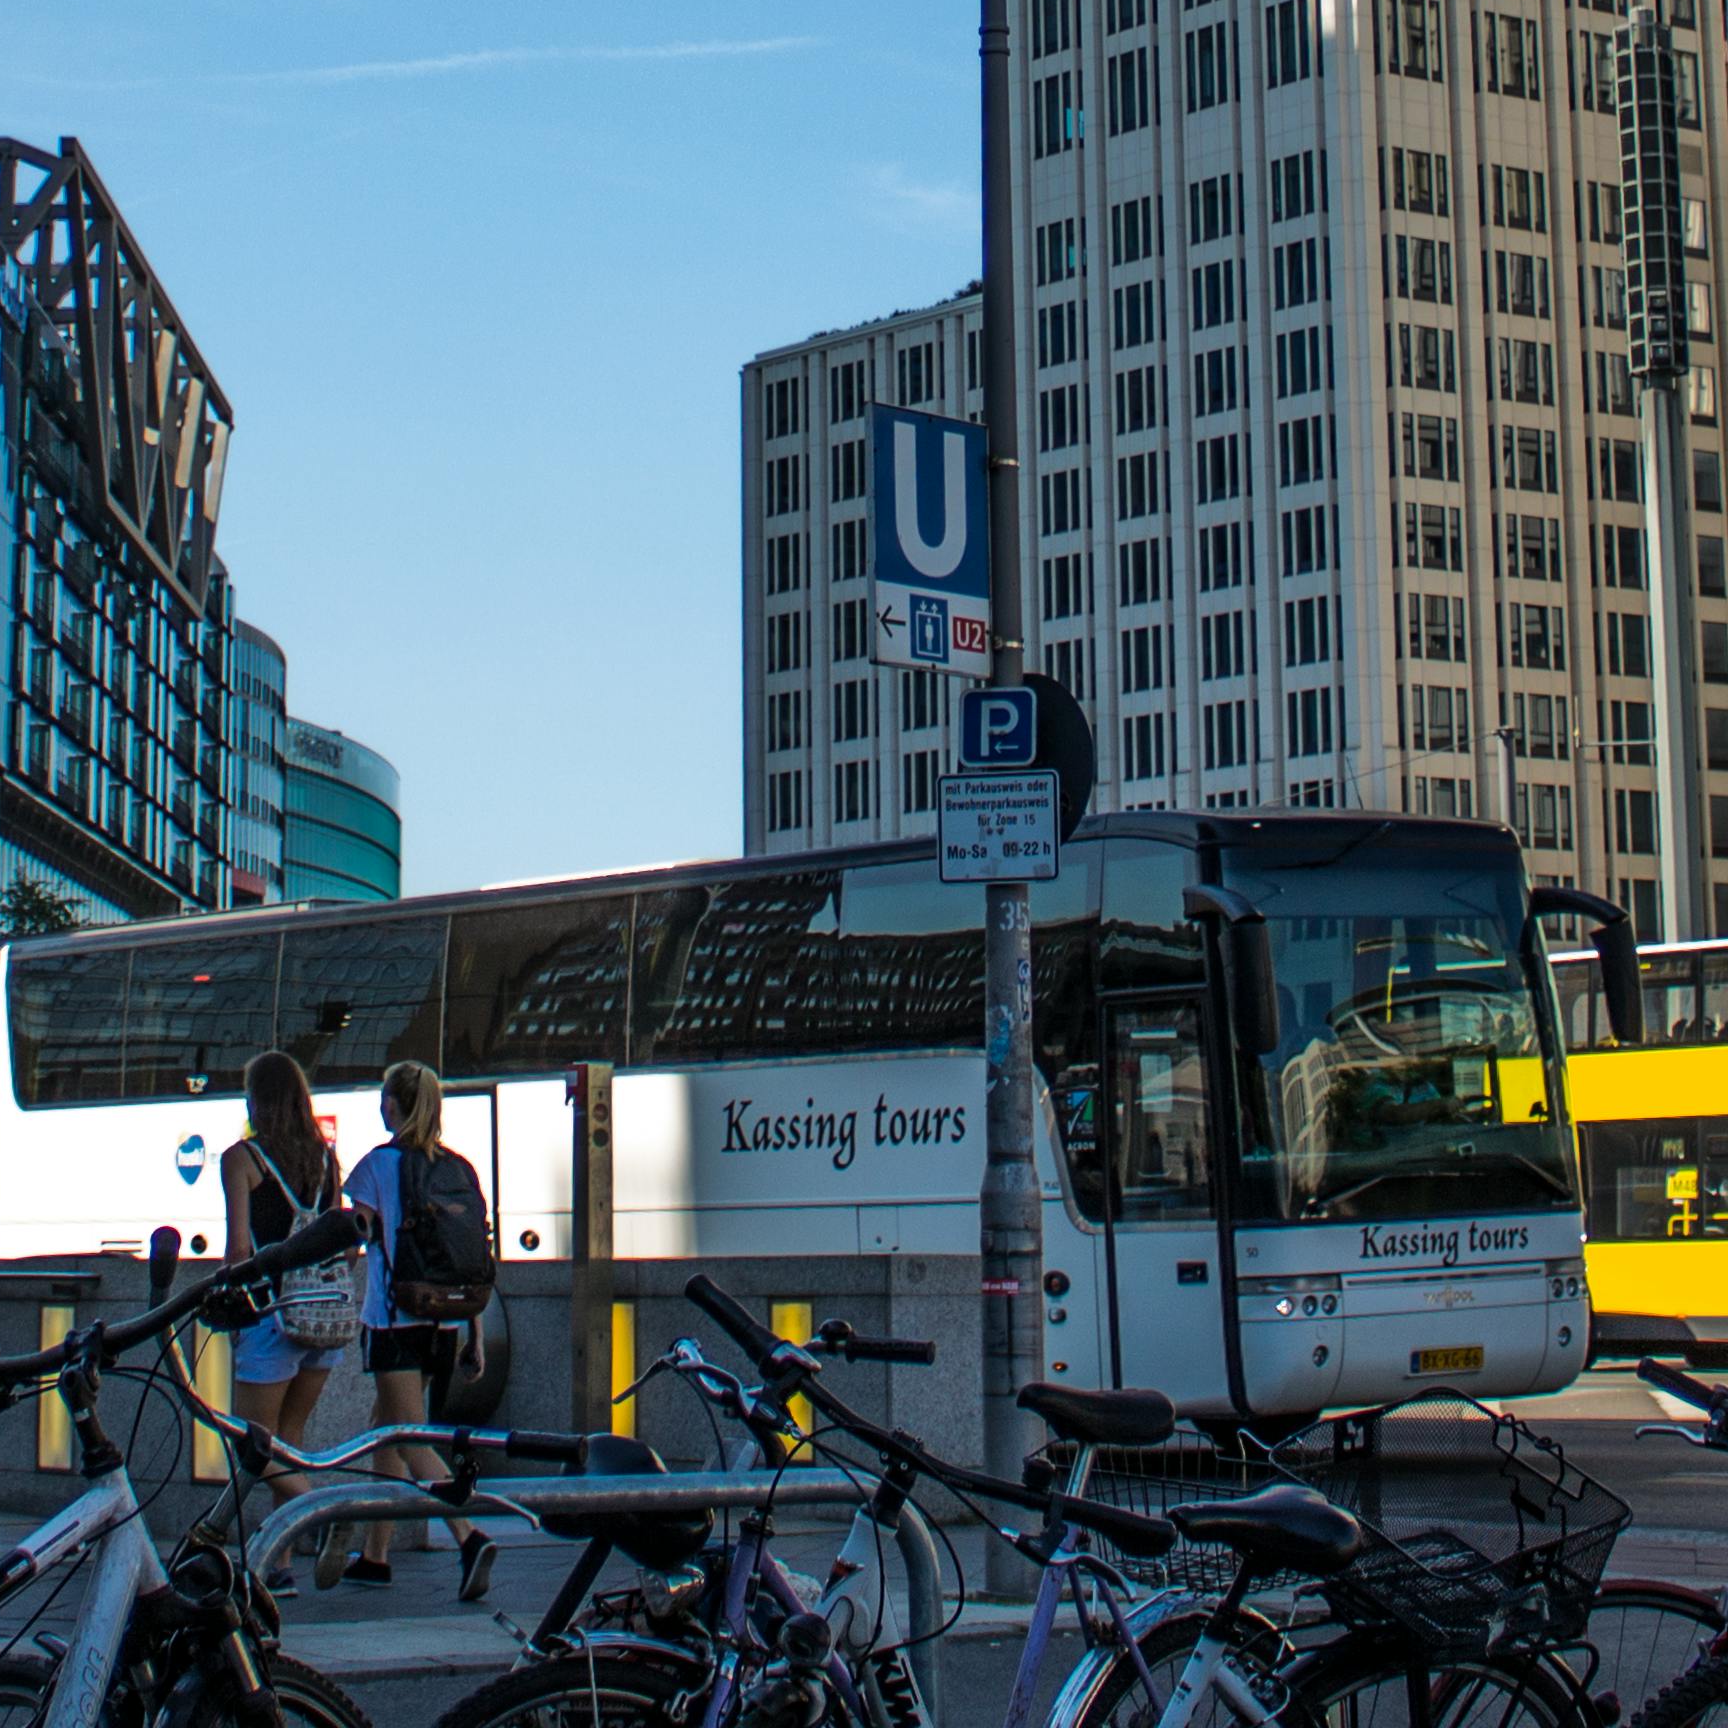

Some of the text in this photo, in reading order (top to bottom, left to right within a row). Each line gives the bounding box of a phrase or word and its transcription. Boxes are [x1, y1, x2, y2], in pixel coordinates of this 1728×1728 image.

[892, 420, 967, 579] U
[956, 619, 983, 650] U2
[979, 698, 1021, 757] P
[945, 779, 1049, 795] mit Parkausweis oder
[945, 796, 1050, 813] Bewohnerparkausweis
[977, 813, 1036, 827] für Zone 15
[946, 840, 1051, 860] Mo-Sa 09-22 h
[720, 1091, 967, 1171] Kassing tours
[1358, 1221, 1530, 1266] Kassing tours
